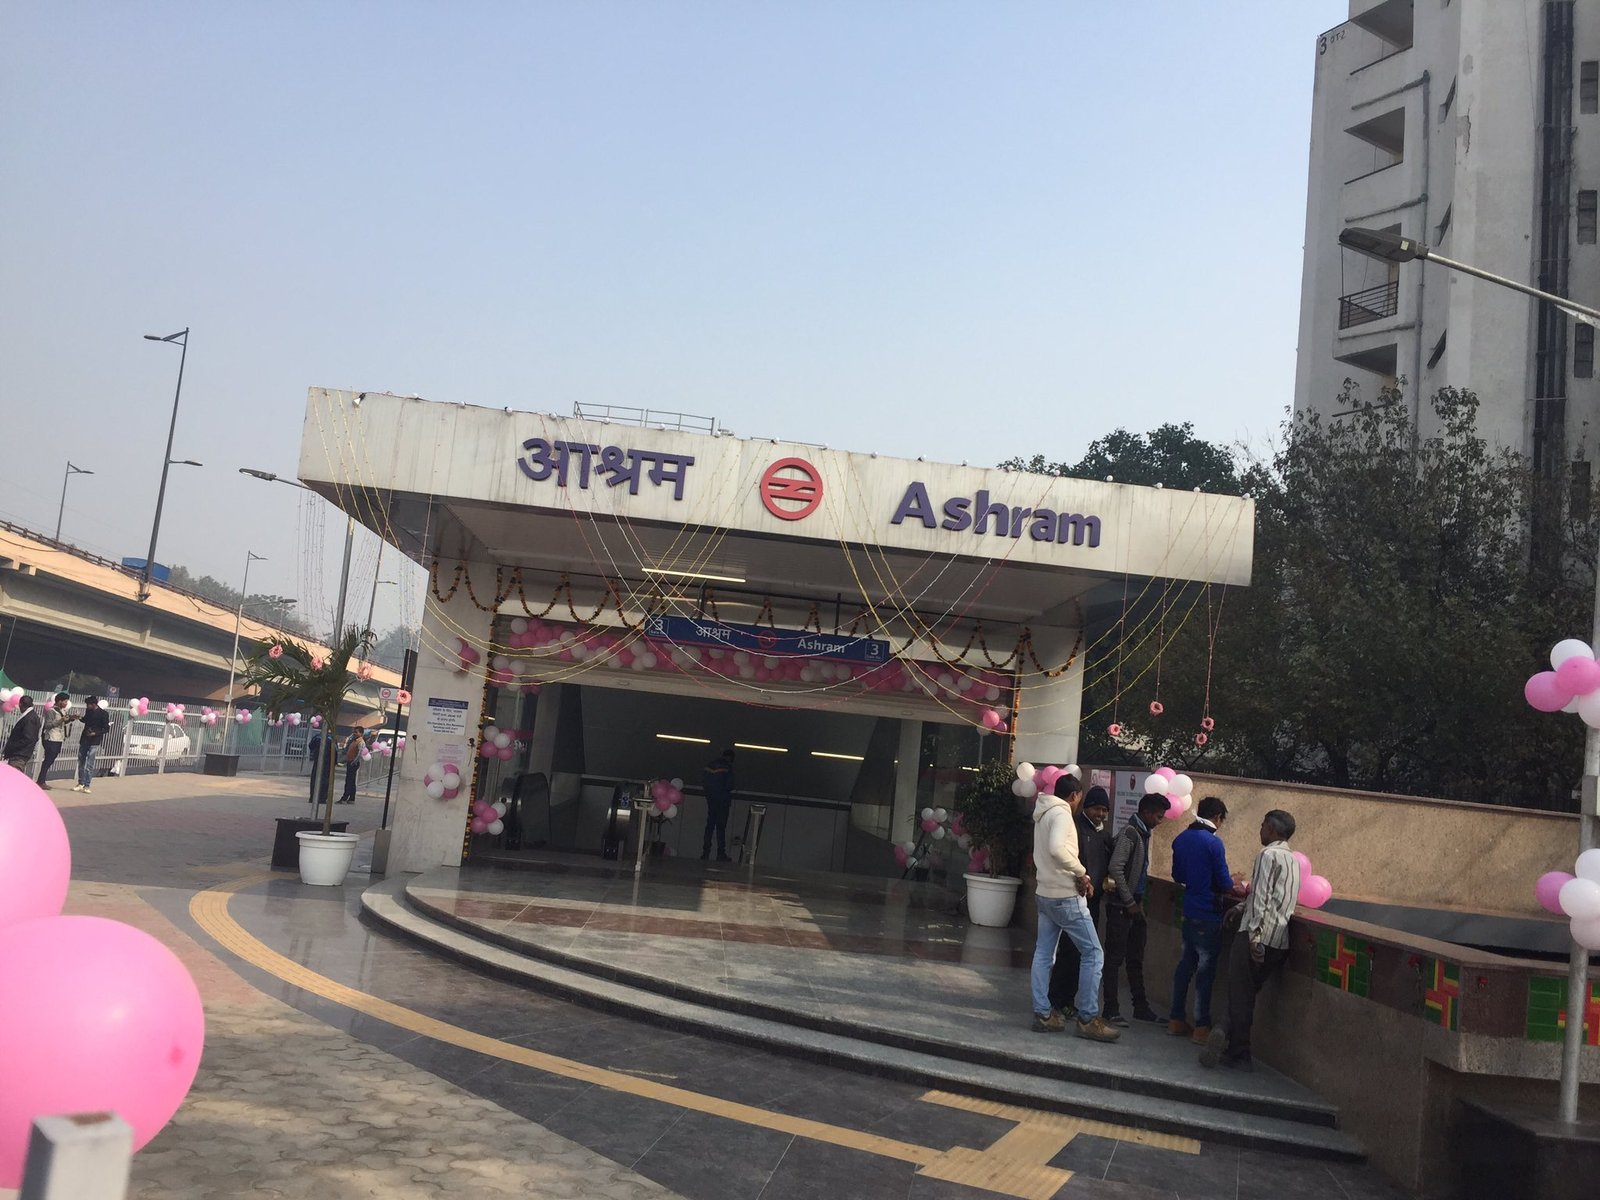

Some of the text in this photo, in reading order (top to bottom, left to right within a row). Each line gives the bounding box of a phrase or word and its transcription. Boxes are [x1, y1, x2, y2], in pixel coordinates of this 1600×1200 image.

[1319, 36, 1327, 56] 3
[517, 437, 696, 501] आश्रम
[890, 481, 1101, 548] Ashram
[654, 619, 664, 631] 3
[695, 626, 733, 640] आश्रम
[797, 637, 846, 653] Ashram
[870, 643, 879, 656] 3
